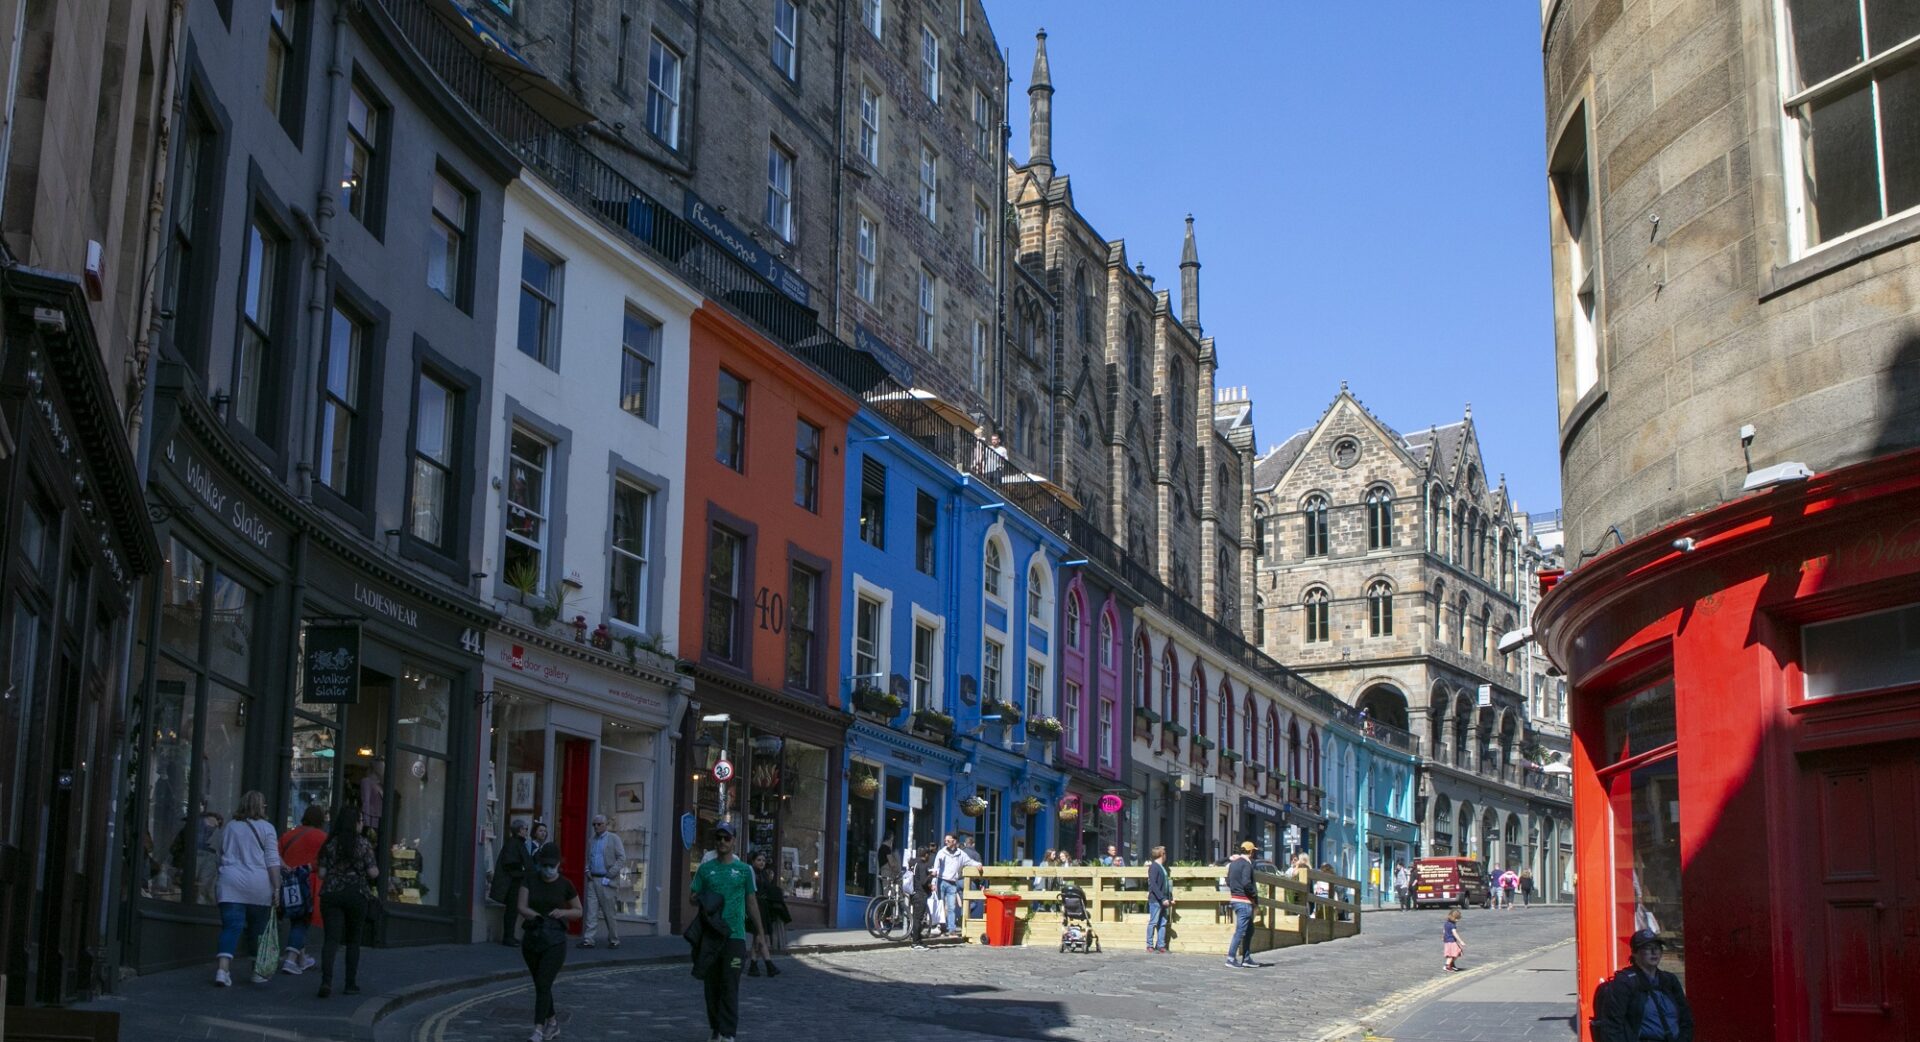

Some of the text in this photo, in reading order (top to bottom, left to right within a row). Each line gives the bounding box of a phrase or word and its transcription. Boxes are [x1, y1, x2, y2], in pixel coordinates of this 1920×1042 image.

[187, 456, 227, 513] Walker
[233, 501, 273, 549] Slater
[354, 583, 418, 629] LADIESWEAR
[755, 586, 783, 635] 40
[544, 664, 569, 683] gallery
[288, 887, 299, 905] B
